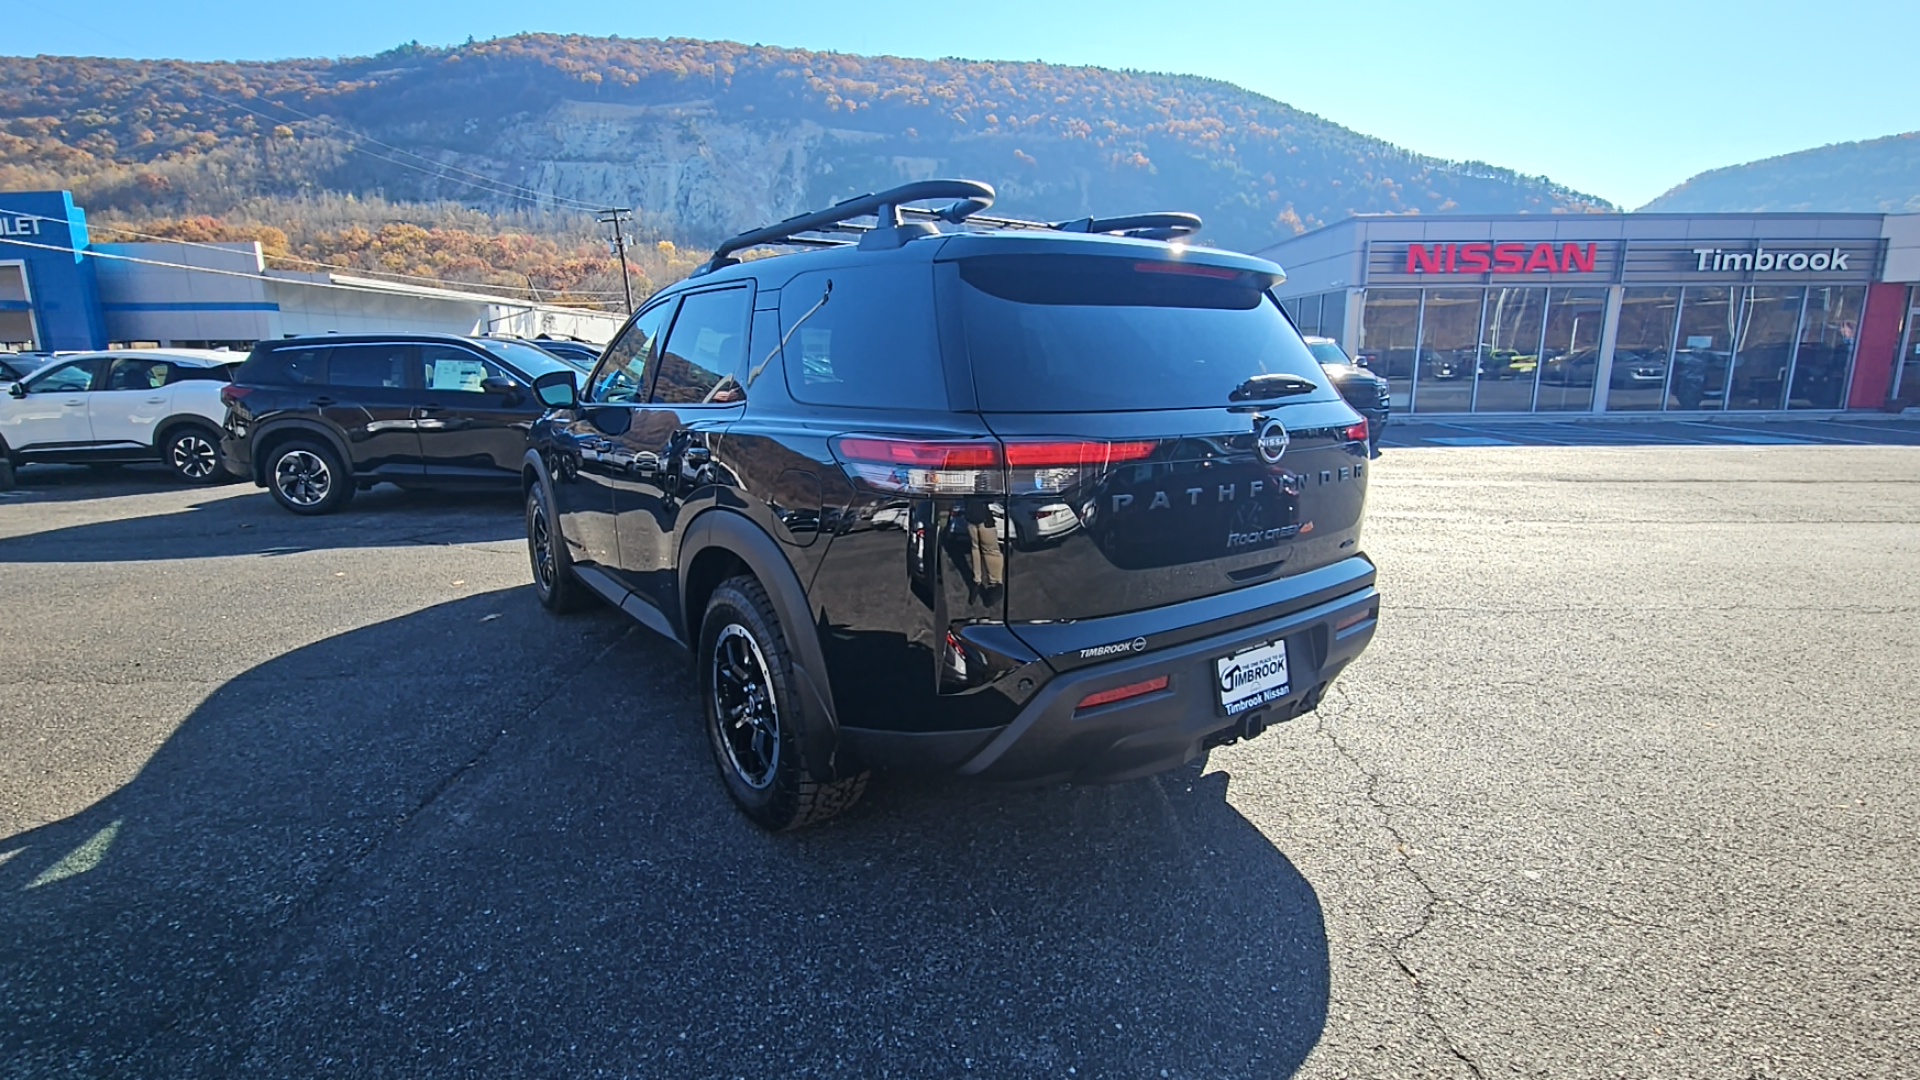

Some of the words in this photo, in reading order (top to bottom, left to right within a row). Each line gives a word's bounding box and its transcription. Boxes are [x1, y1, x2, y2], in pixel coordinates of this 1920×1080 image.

[0, 216, 42, 236] LET
[1406, 242, 1598, 275] NISSAN
[1692, 247, 1851, 272] Timbrook
[1257, 433, 1290, 448] NISSAN
[1111, 462, 1364, 513] PATHFINDER
[1080, 641, 1132, 659] TIMBROOK
[1221, 659, 1285, 692] TIMBROOK
[1225, 693, 1264, 716] Timbrook
[1263, 685, 1290, 702] Nissan
